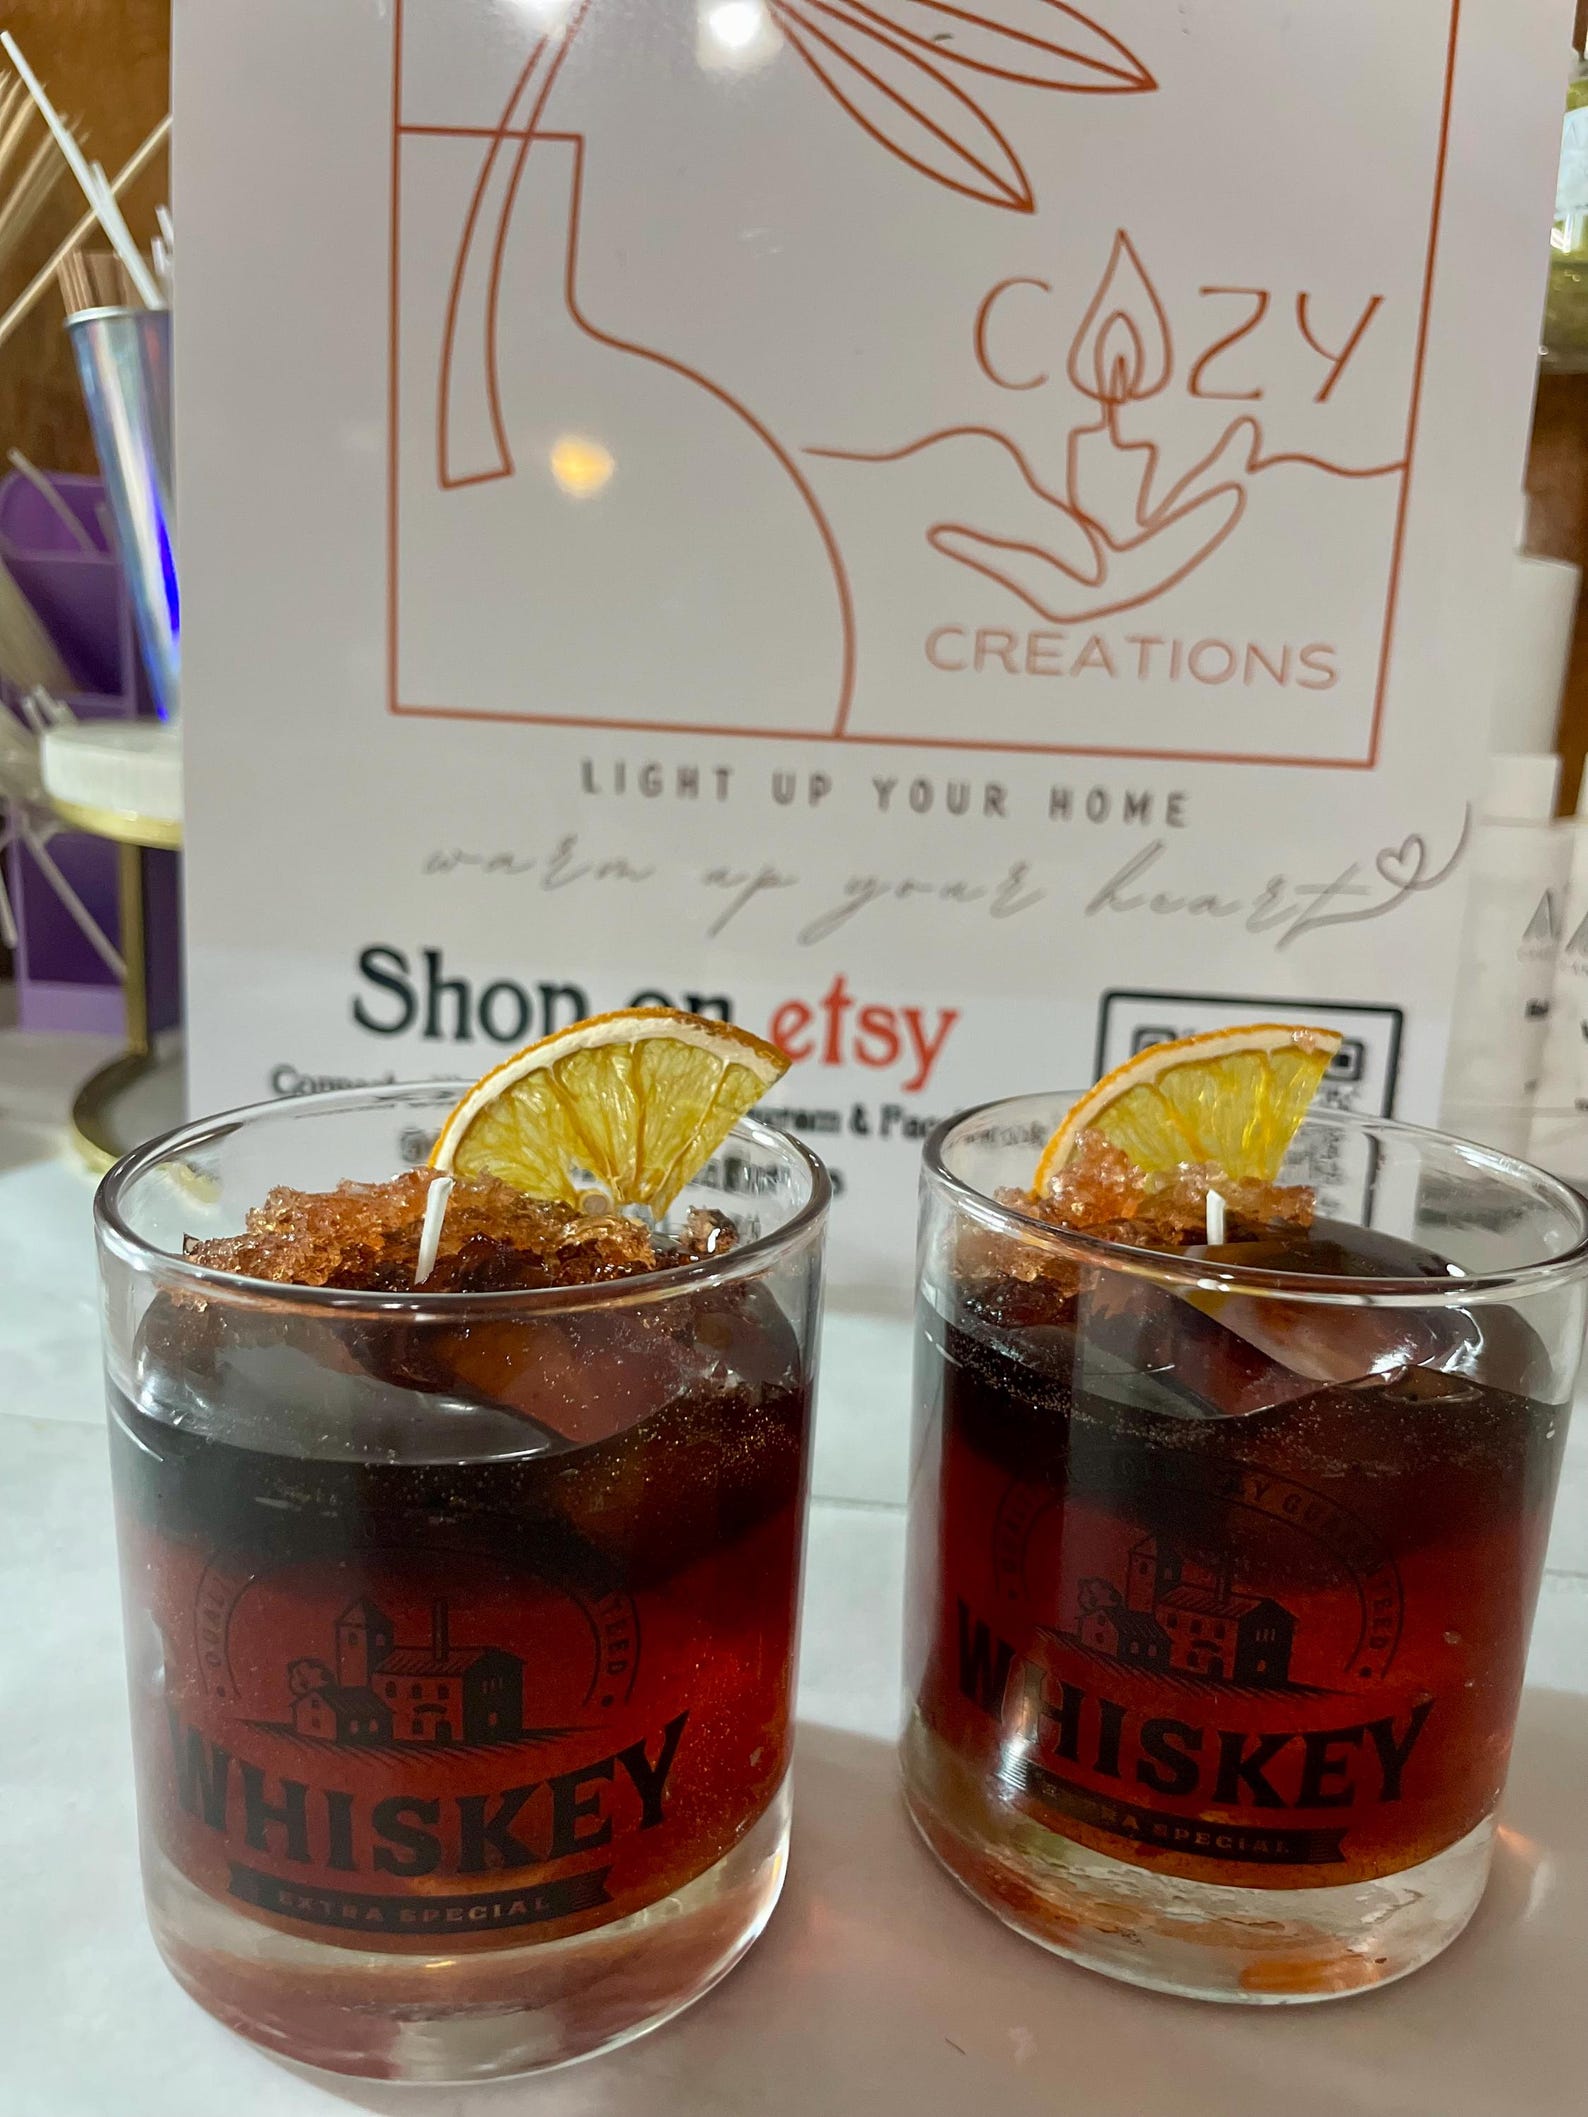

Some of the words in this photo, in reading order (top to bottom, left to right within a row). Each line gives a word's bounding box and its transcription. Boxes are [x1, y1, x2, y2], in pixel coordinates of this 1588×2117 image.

[973, 230, 1384, 402] COZY
[925, 624, 1341, 692] CREATIONS
[581, 755, 735, 803] LIGHT
[770, 770, 833, 807] UP
[871, 774, 1010, 819] YOUR
[1048, 785, 1190, 828] HOME
[701, 862, 800, 939] up
[1084, 836, 1385, 952] heart
[768, 972, 961, 1095] etsy
[956, 1592, 1434, 1810] WHISKEY
[169, 1708, 690, 1878] WHISKEY
[277, 1888, 385, 1924] EXTRA
[400, 1896, 550, 1925] SPECIAL
